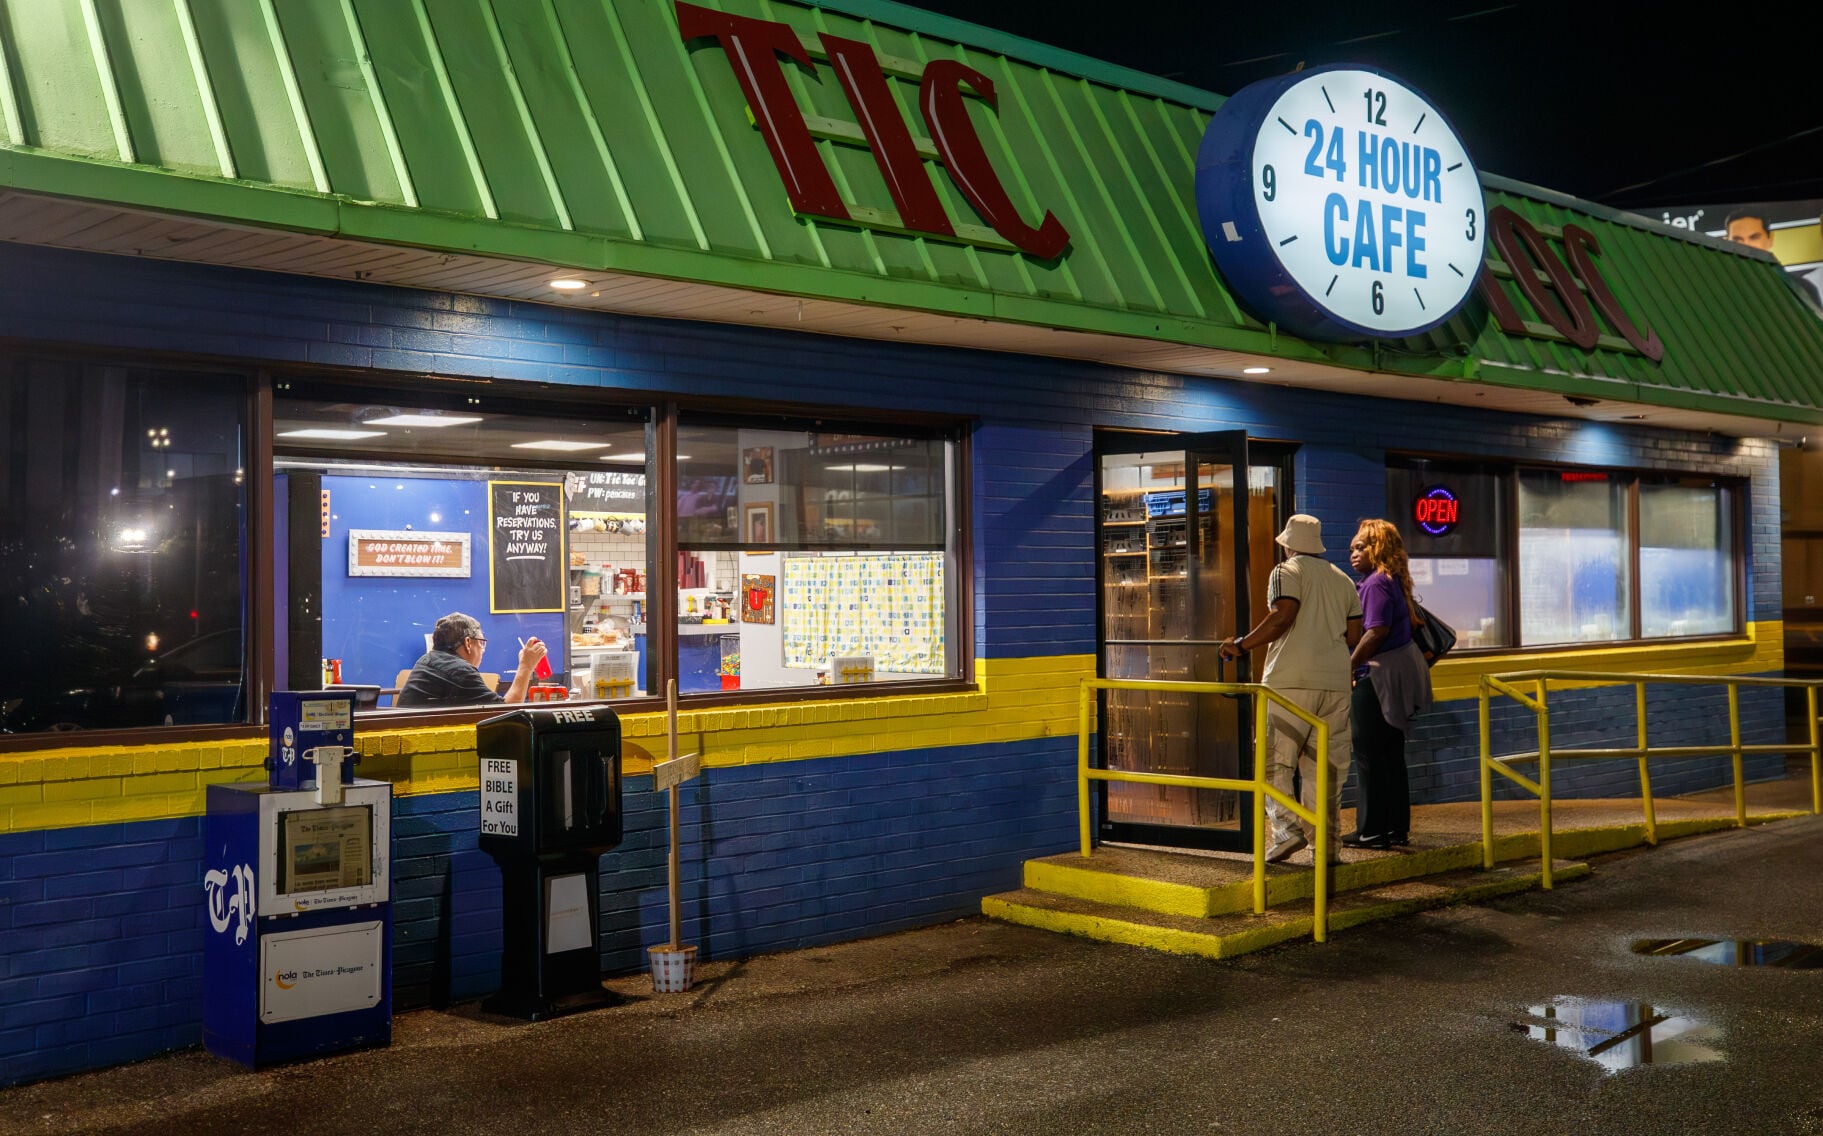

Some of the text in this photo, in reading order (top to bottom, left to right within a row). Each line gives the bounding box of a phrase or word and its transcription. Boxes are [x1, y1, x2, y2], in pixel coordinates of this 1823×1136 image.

[1363, 87, 1388, 127] 12
[674, 0, 1070, 260] TIC
[1303, 118, 1442, 204] 24 HOUR
[1262, 164, 1276, 202] 9
[1465, 208, 1476, 242] 3
[1323, 192, 1428, 280] CAFE
[1372, 280, 1384, 315] 6
[512, 492, 540, 503] IF YOU
[515, 505, 538, 516] HAVE
[1415, 499, 1458, 525] OPEN
[497, 517, 557, 529] RESERVATIONS,
[510, 530, 544, 541] TRY US
[367, 543, 387, 553] GOD
[389, 543, 428, 553] CREATED
[506, 543, 547, 554] ANYWAY!
[376, 554, 445, 564] DON'T BLOW IT!
[552, 710, 595, 724] FREE
[487, 760, 511, 773] FREE
[486, 780, 513, 793] BIBLE
[486, 801, 513, 814] A Gift
[483, 820, 517, 834] For You
[204, 863, 256, 946] TP
[278, 970, 298, 981] nola
[302, 971, 314, 979] The
